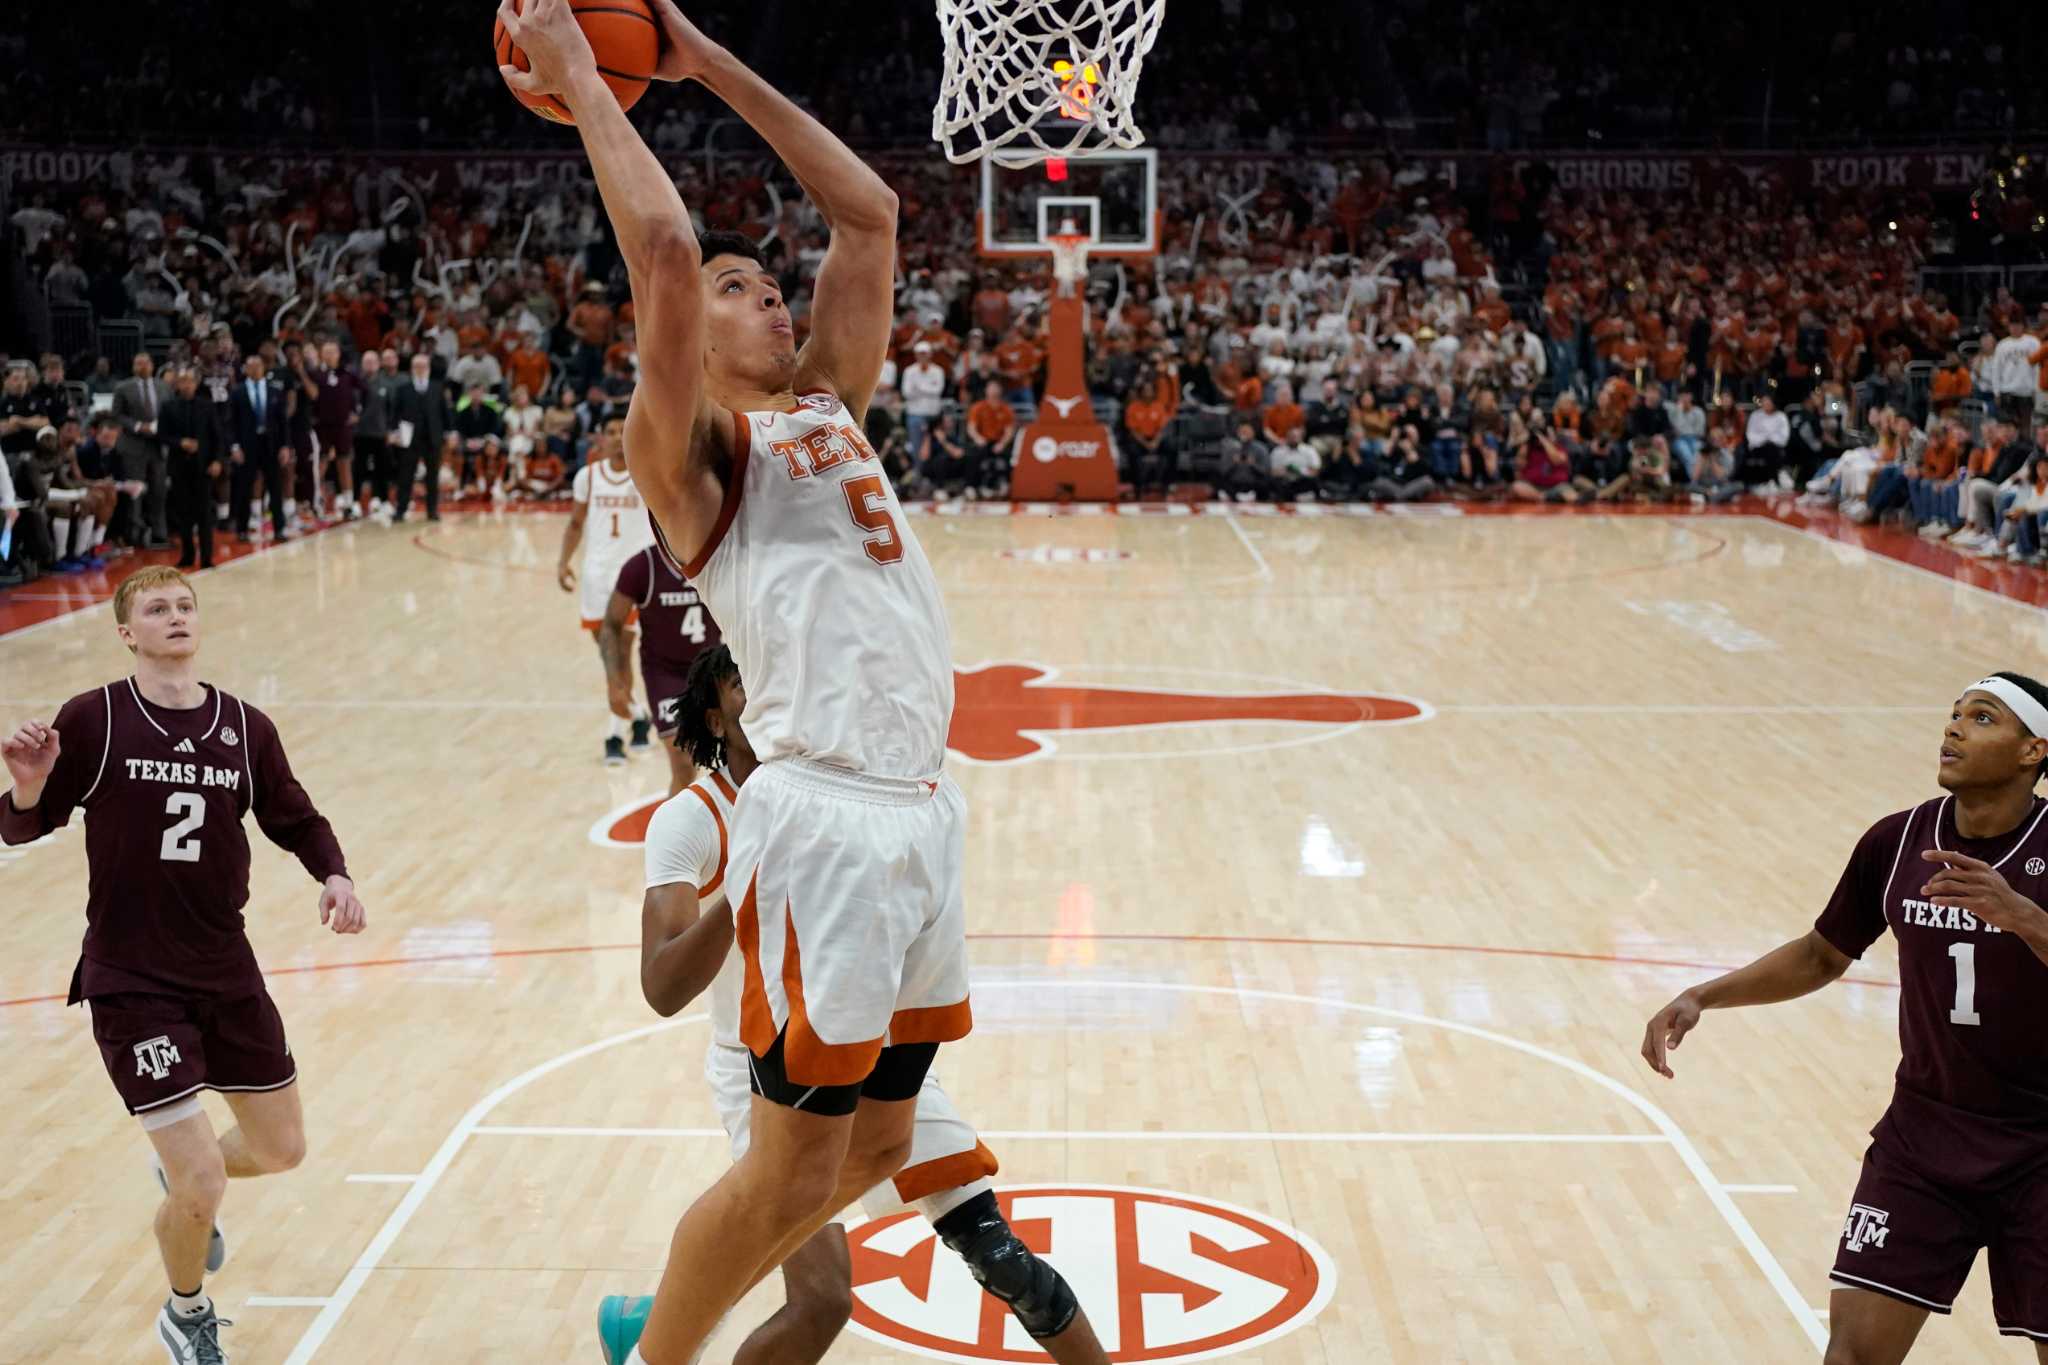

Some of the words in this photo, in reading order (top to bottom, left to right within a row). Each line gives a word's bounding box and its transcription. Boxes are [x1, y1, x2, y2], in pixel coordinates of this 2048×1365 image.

[611, 513, 620, 538] 1
[841, 473, 904, 565] 5
[680, 605, 706, 643] 4
[125, 758, 197, 785] TEXAS
[202, 765, 240, 790] A&M
[160, 791, 206, 862] 2
[2027, 858, 2044, 874] SEC
[1902, 899, 1977, 931] TEXAS
[1948, 942, 1980, 1025] 1
